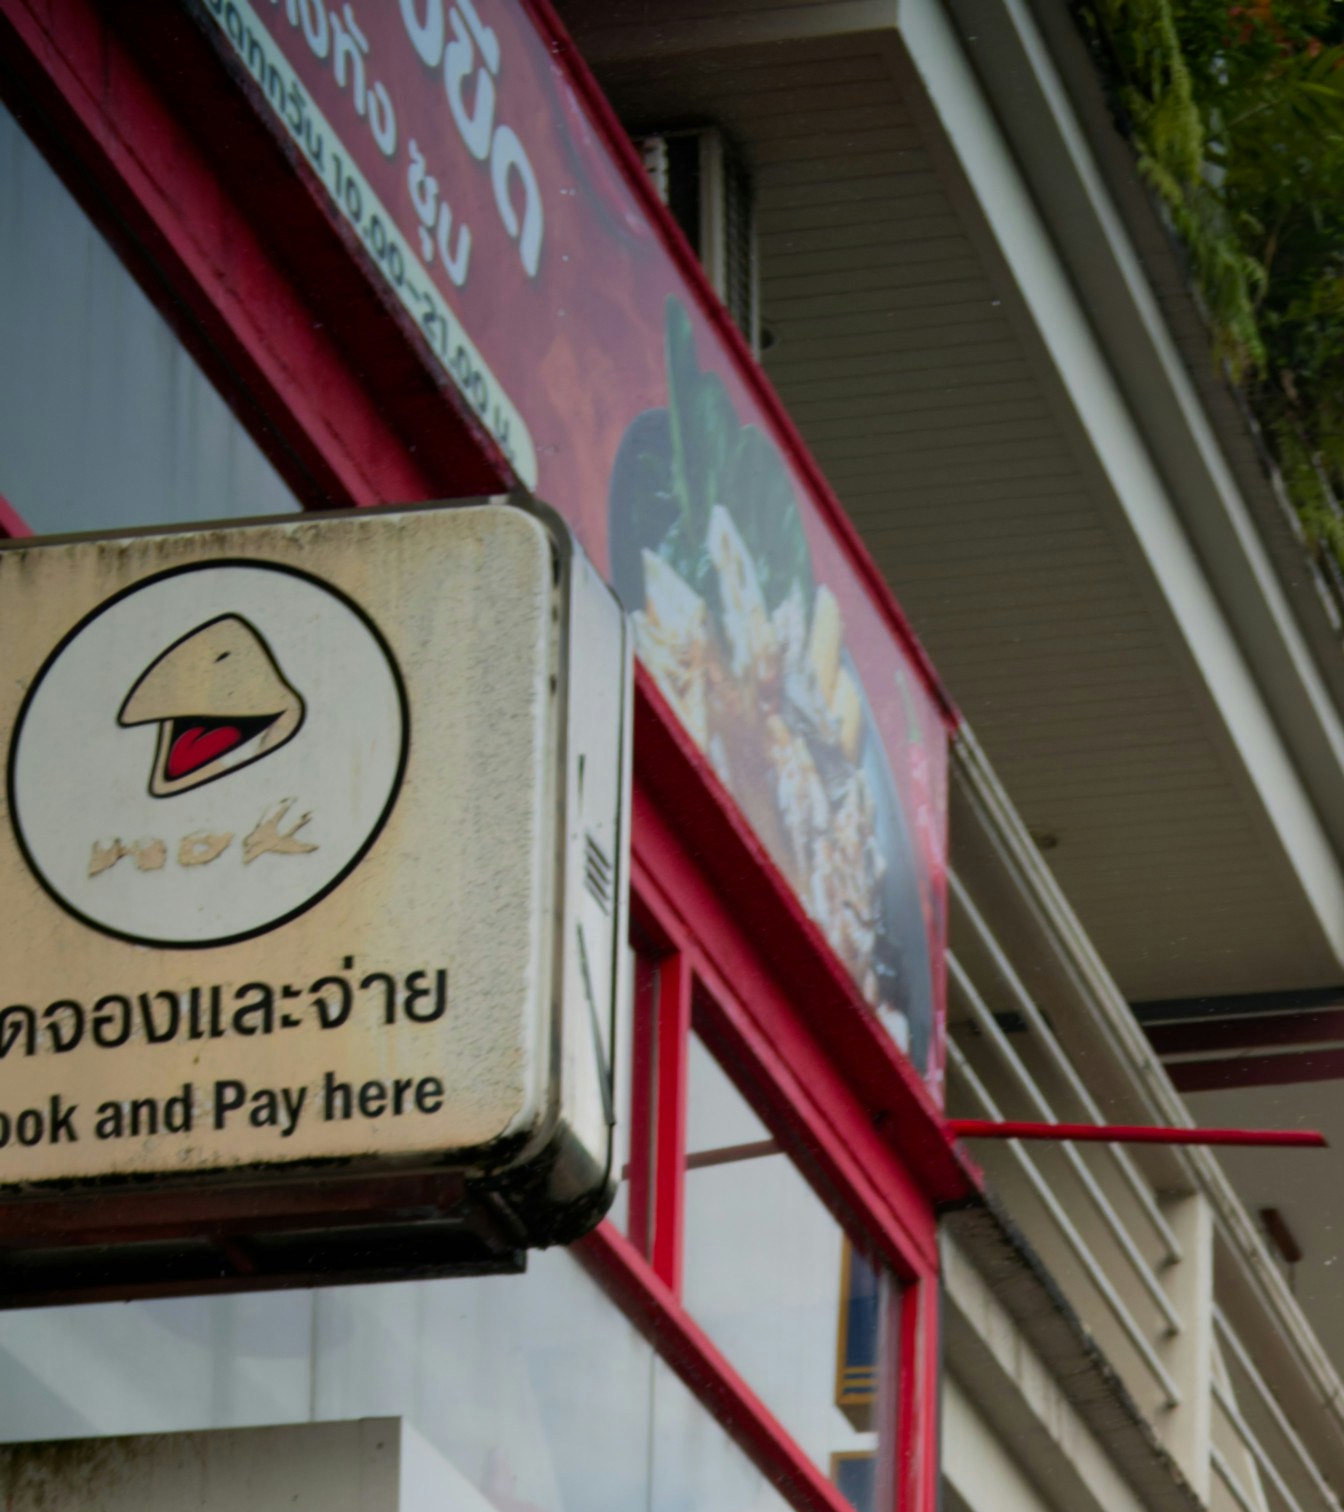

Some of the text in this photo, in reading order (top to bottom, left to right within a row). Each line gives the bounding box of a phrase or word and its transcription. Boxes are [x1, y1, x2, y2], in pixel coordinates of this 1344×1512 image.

[408, 138, 470, 286] ซุป
[95, 1082, 192, 1139] and
[213, 1080, 307, 1137] Pay
[323, 1071, 444, 1121] here
